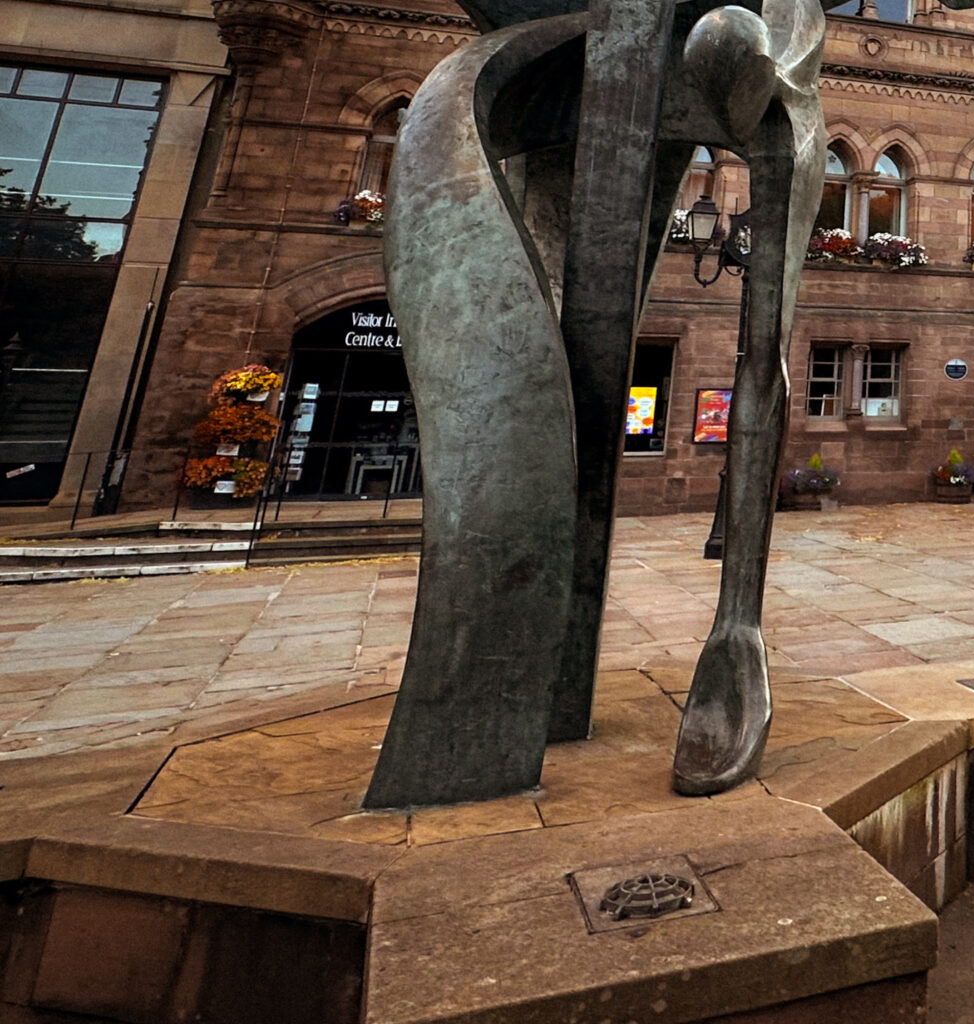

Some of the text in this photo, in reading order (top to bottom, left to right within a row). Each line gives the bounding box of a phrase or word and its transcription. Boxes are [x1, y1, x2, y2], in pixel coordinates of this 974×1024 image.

[352, 312, 383, 328] Visitor
[345, 331, 384, 347] Centre
[384, 335, 395, 348] &
